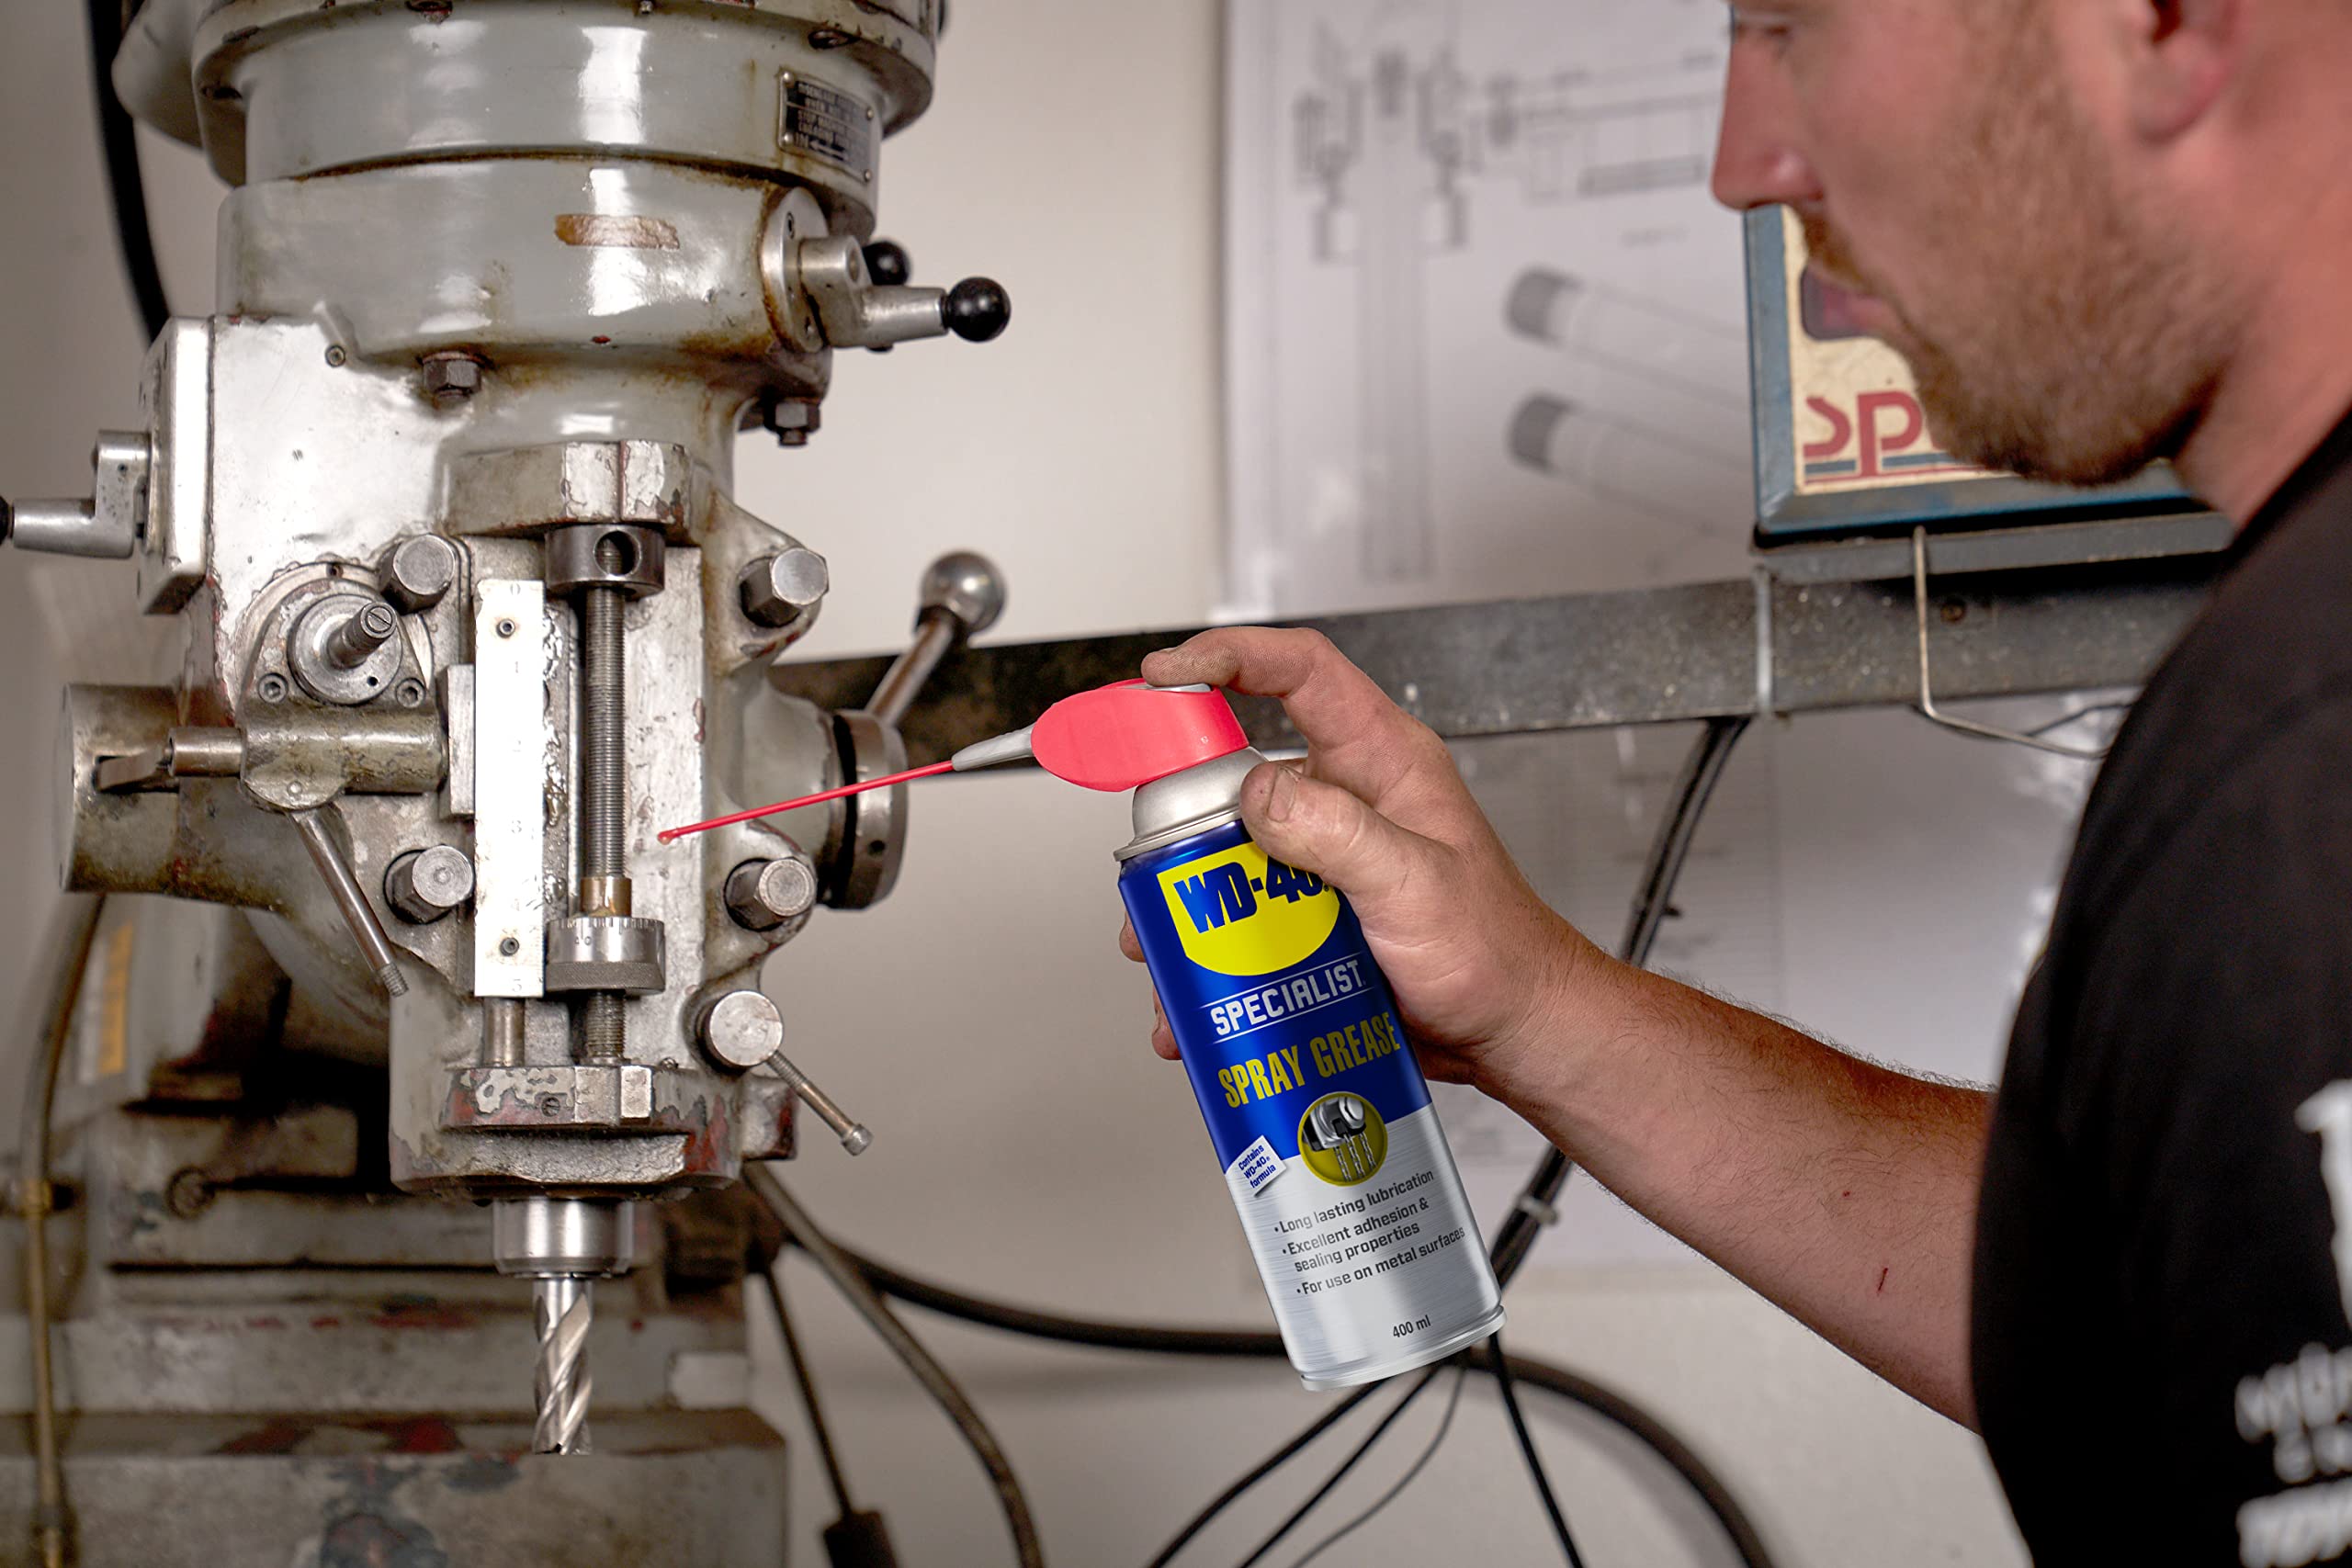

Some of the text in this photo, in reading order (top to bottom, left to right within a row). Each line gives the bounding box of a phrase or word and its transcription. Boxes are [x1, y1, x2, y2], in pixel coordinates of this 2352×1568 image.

[1211, 959, 1363, 1036] SPECIALIST
[1217, 1011, 1401, 1108] SPRAY GREASE
[1238, 1145, 1265, 1170] Contains
[1250, 1164, 1277, 1189] formula
[1279, 1169, 1434, 1234] Long lasting lubrication
[1286, 1196, 1430, 1255] Excellent adhesion &
[1294, 1222, 1420, 1272] sealing properties
[1301, 1226, 1465, 1295] For use on metal surfaces
[1392, 1314, 1431, 1338] 400 ml
